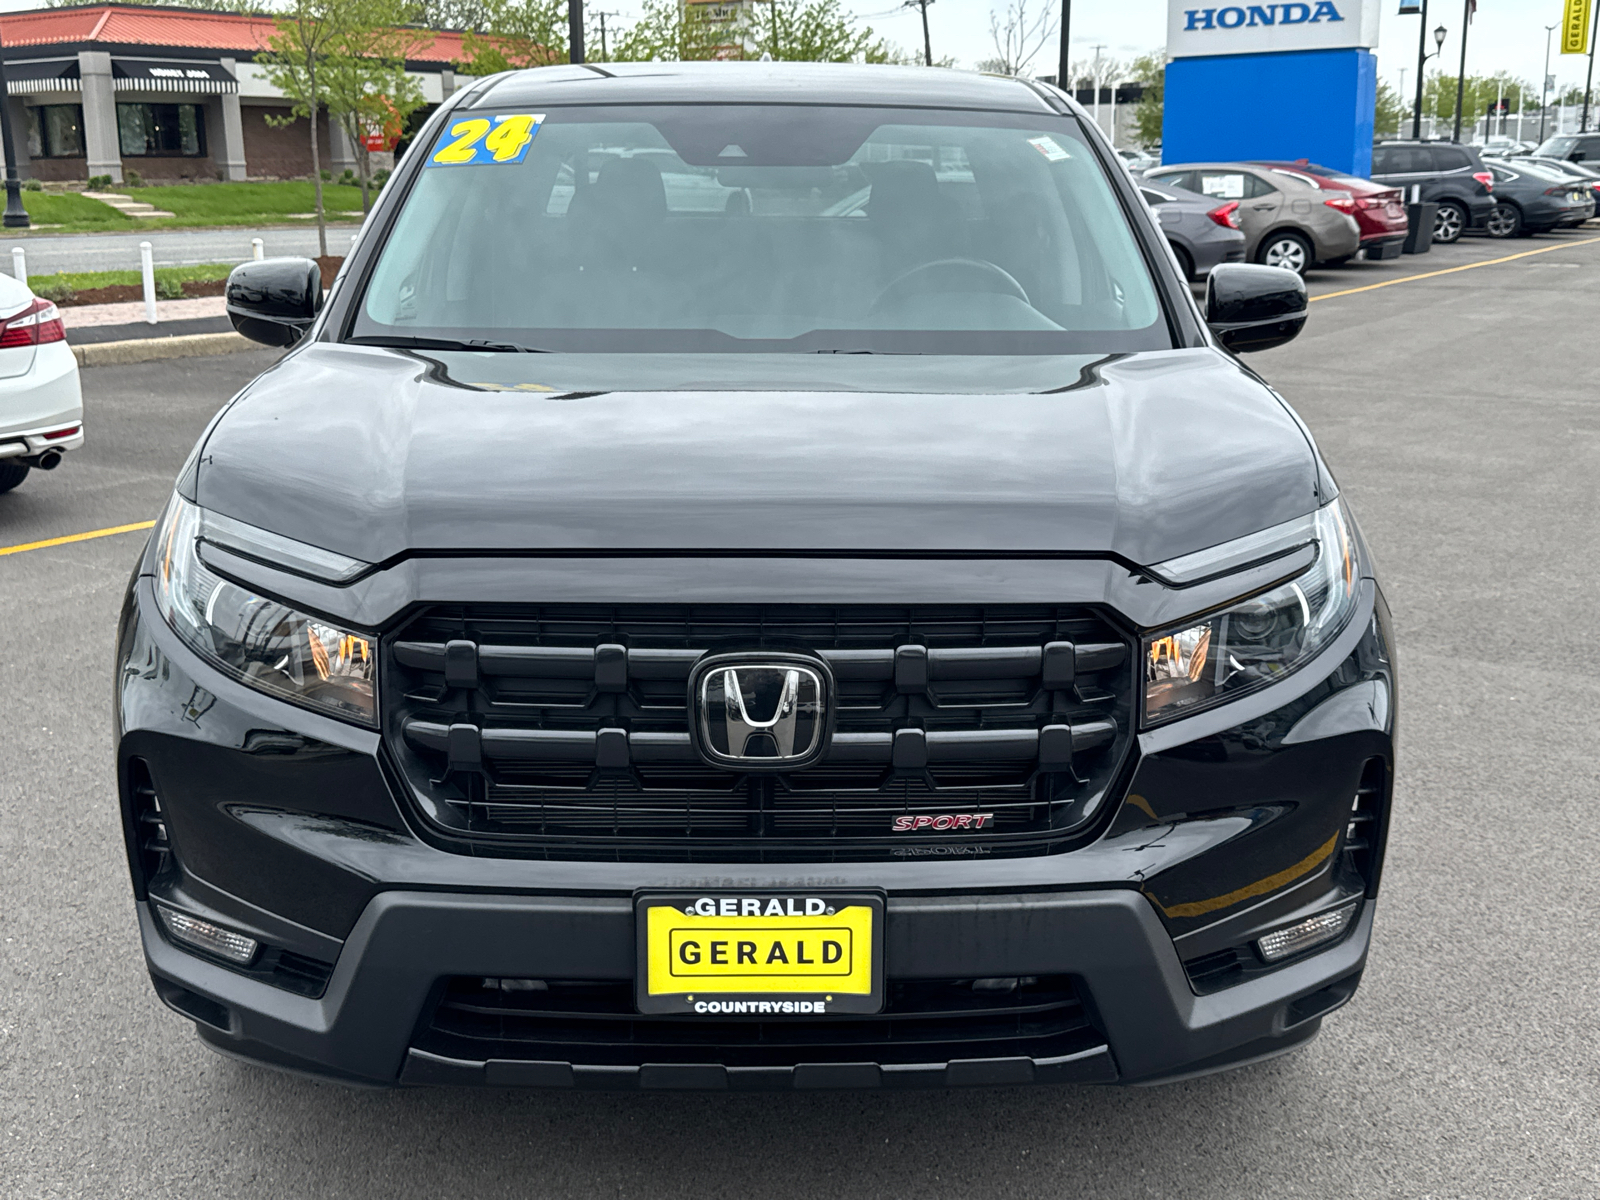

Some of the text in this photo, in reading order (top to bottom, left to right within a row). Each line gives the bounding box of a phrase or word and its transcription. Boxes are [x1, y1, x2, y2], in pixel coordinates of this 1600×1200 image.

[1184, 1, 1344, 31] HONDA
[1569, 0, 1583, 47] GERALD
[433, 114, 535, 164] 24
[891, 812, 994, 832] SPORT
[694, 897, 826, 917] GERALD
[678, 940, 843, 965] GERALD
[694, 1000, 826, 1014] COUNTRYSIDE
